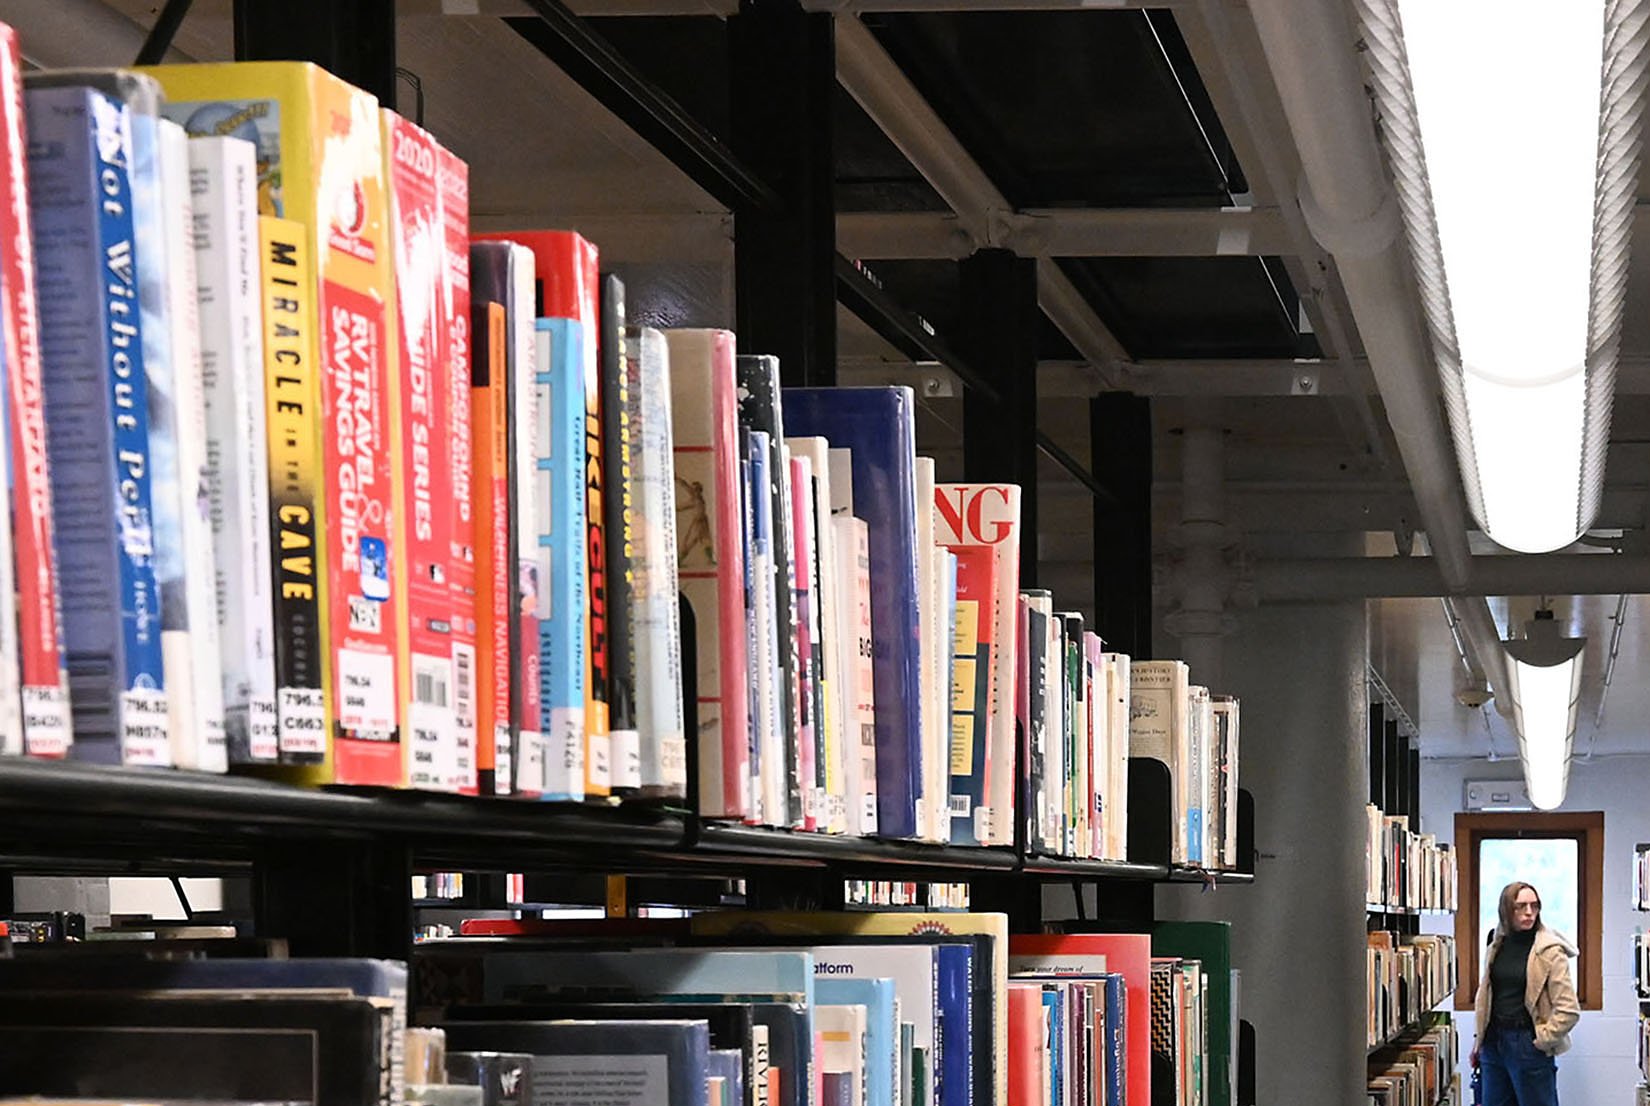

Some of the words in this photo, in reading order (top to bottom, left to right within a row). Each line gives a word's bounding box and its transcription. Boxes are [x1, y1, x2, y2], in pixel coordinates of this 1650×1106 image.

[107, 240, 140, 433] Without
[270, 239, 304, 417] MIRACLE
[331, 307, 359, 456] SAVINGS
[352, 312, 376, 361] RV
[286, 460, 302, 493] THE
[355, 366, 381, 492] TRAVEL
[412, 425, 437, 541] SERIES
[619, 410, 636, 560] ARMSTRONG
[278, 504, 314, 602] CAVE
[340, 460, 363, 574] GUIDE
[493, 496, 509, 616] WILDERNESS
[494, 620, 510, 728] NAVIGATIO
[1054, 965, 1075, 974] dream
